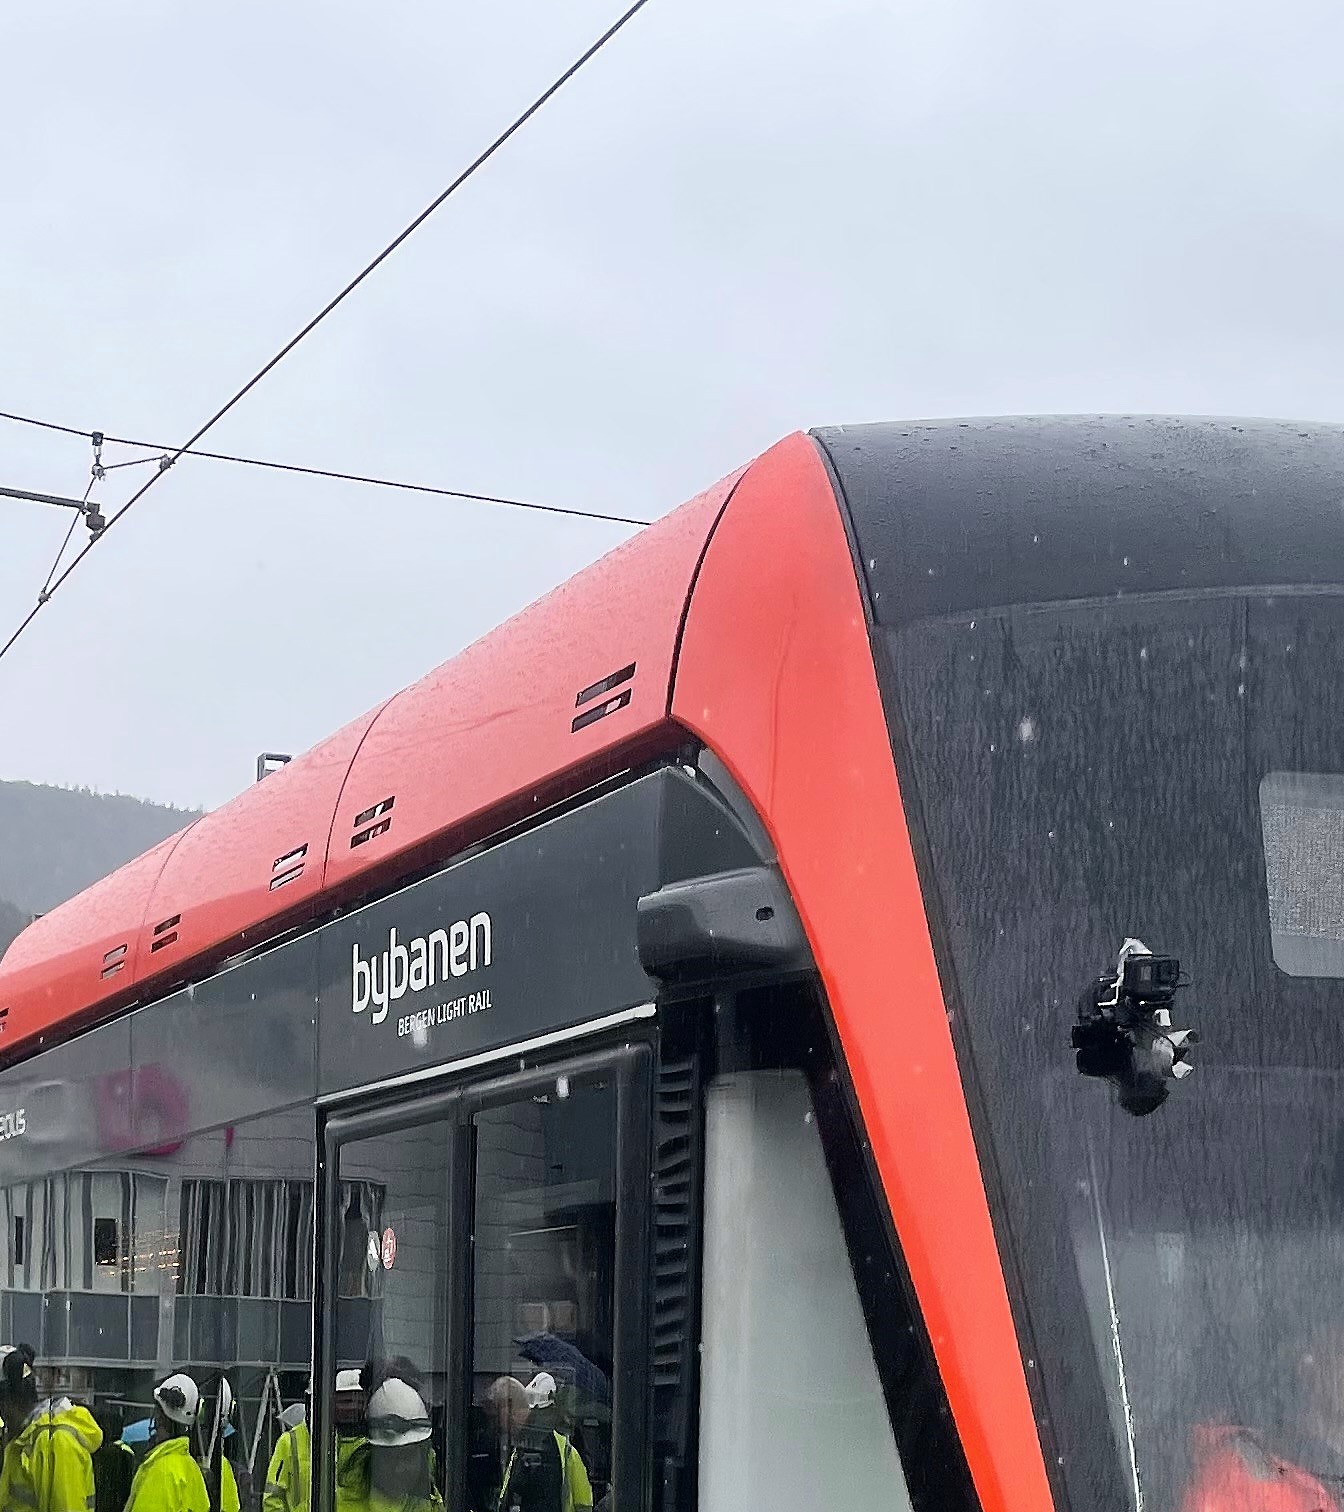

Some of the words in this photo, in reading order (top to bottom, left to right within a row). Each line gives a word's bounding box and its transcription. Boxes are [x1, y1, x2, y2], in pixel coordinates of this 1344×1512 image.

[352, 911, 492, 1025] bybanen
[397, 1007, 436, 1037] BERGEN
[437, 997, 467, 1024] LIGHT
[468, 989, 492, 1015] RAIL
